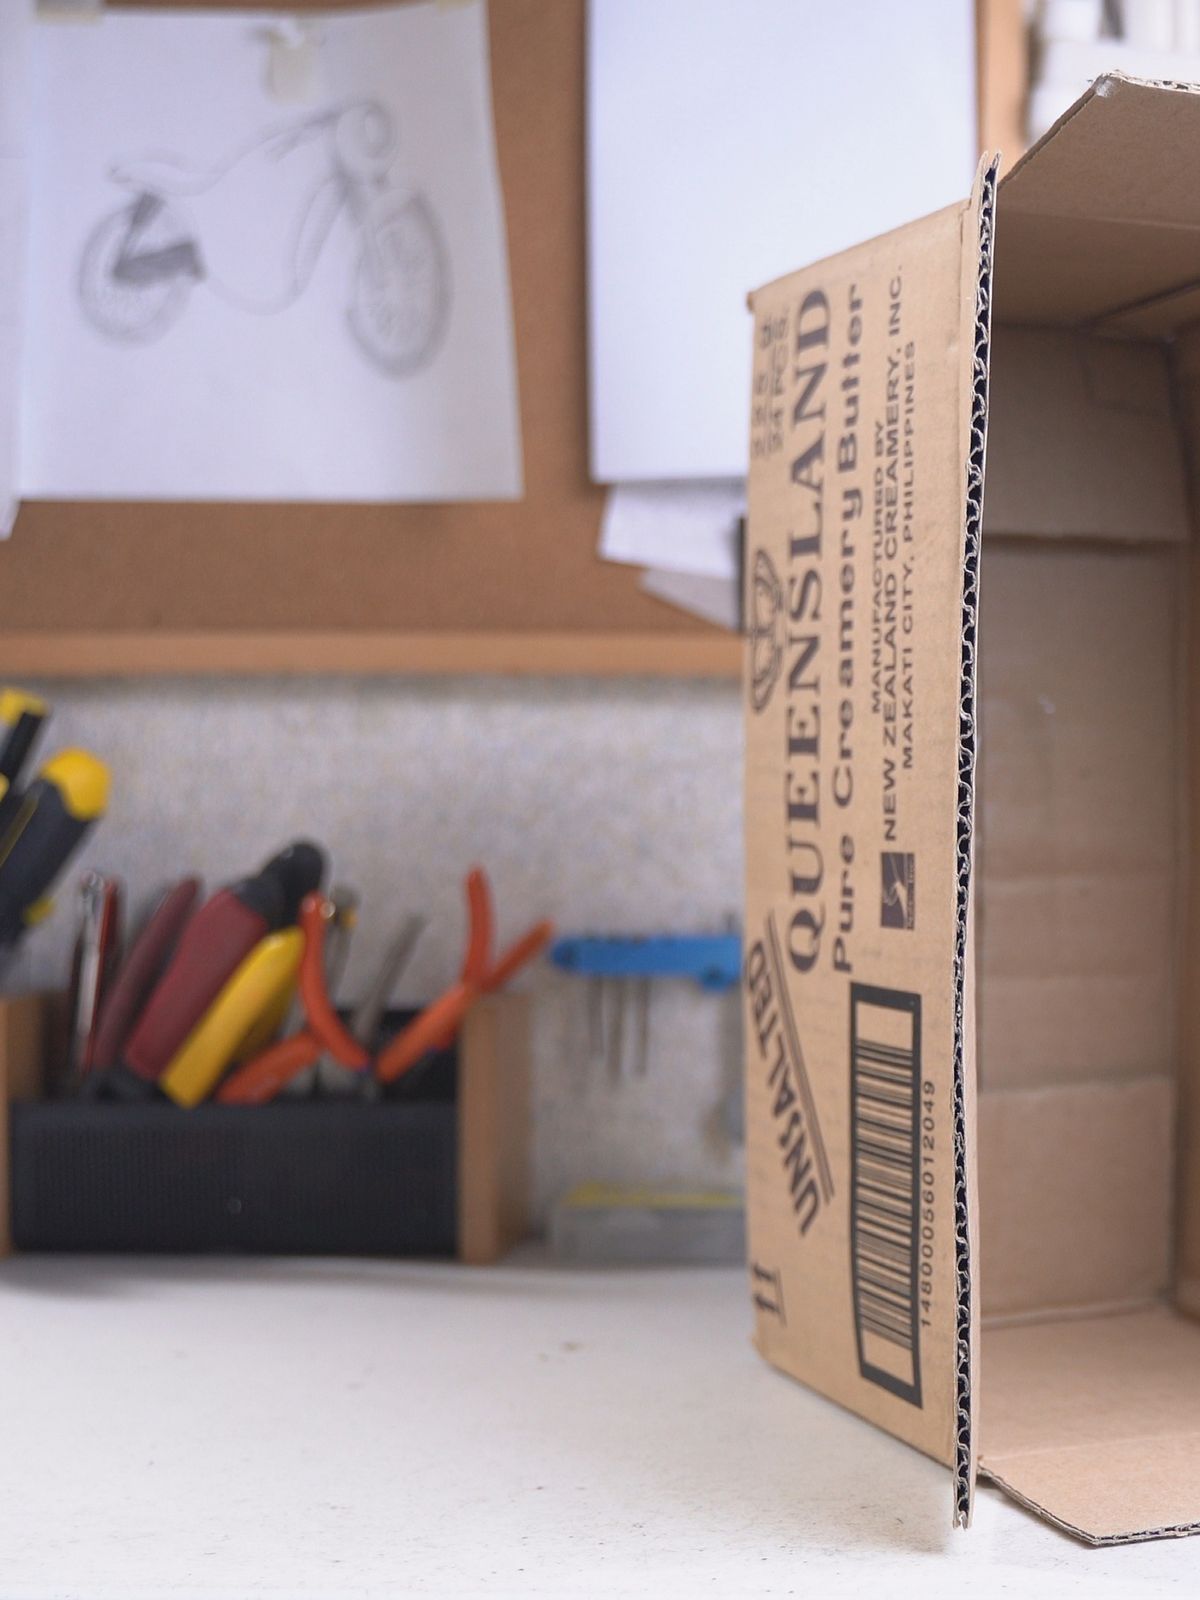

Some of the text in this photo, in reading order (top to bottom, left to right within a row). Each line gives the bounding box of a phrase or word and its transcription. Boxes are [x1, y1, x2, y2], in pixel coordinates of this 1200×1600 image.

[787, 288, 830, 974] QUEENSLAND
[832, 284, 864, 973] Pure Creamery Butter
[871, 421, 885, 714] MANUFACTURED BY
[883, 265, 903, 842] NEW ZEALAND CREAMERY, INC.
[902, 341, 916, 770] MAKATI CITY, PHILIPPINES
[748, 940, 820, 1237] UNSALTED
[920, 1081, 936, 1328] 14800056012049
